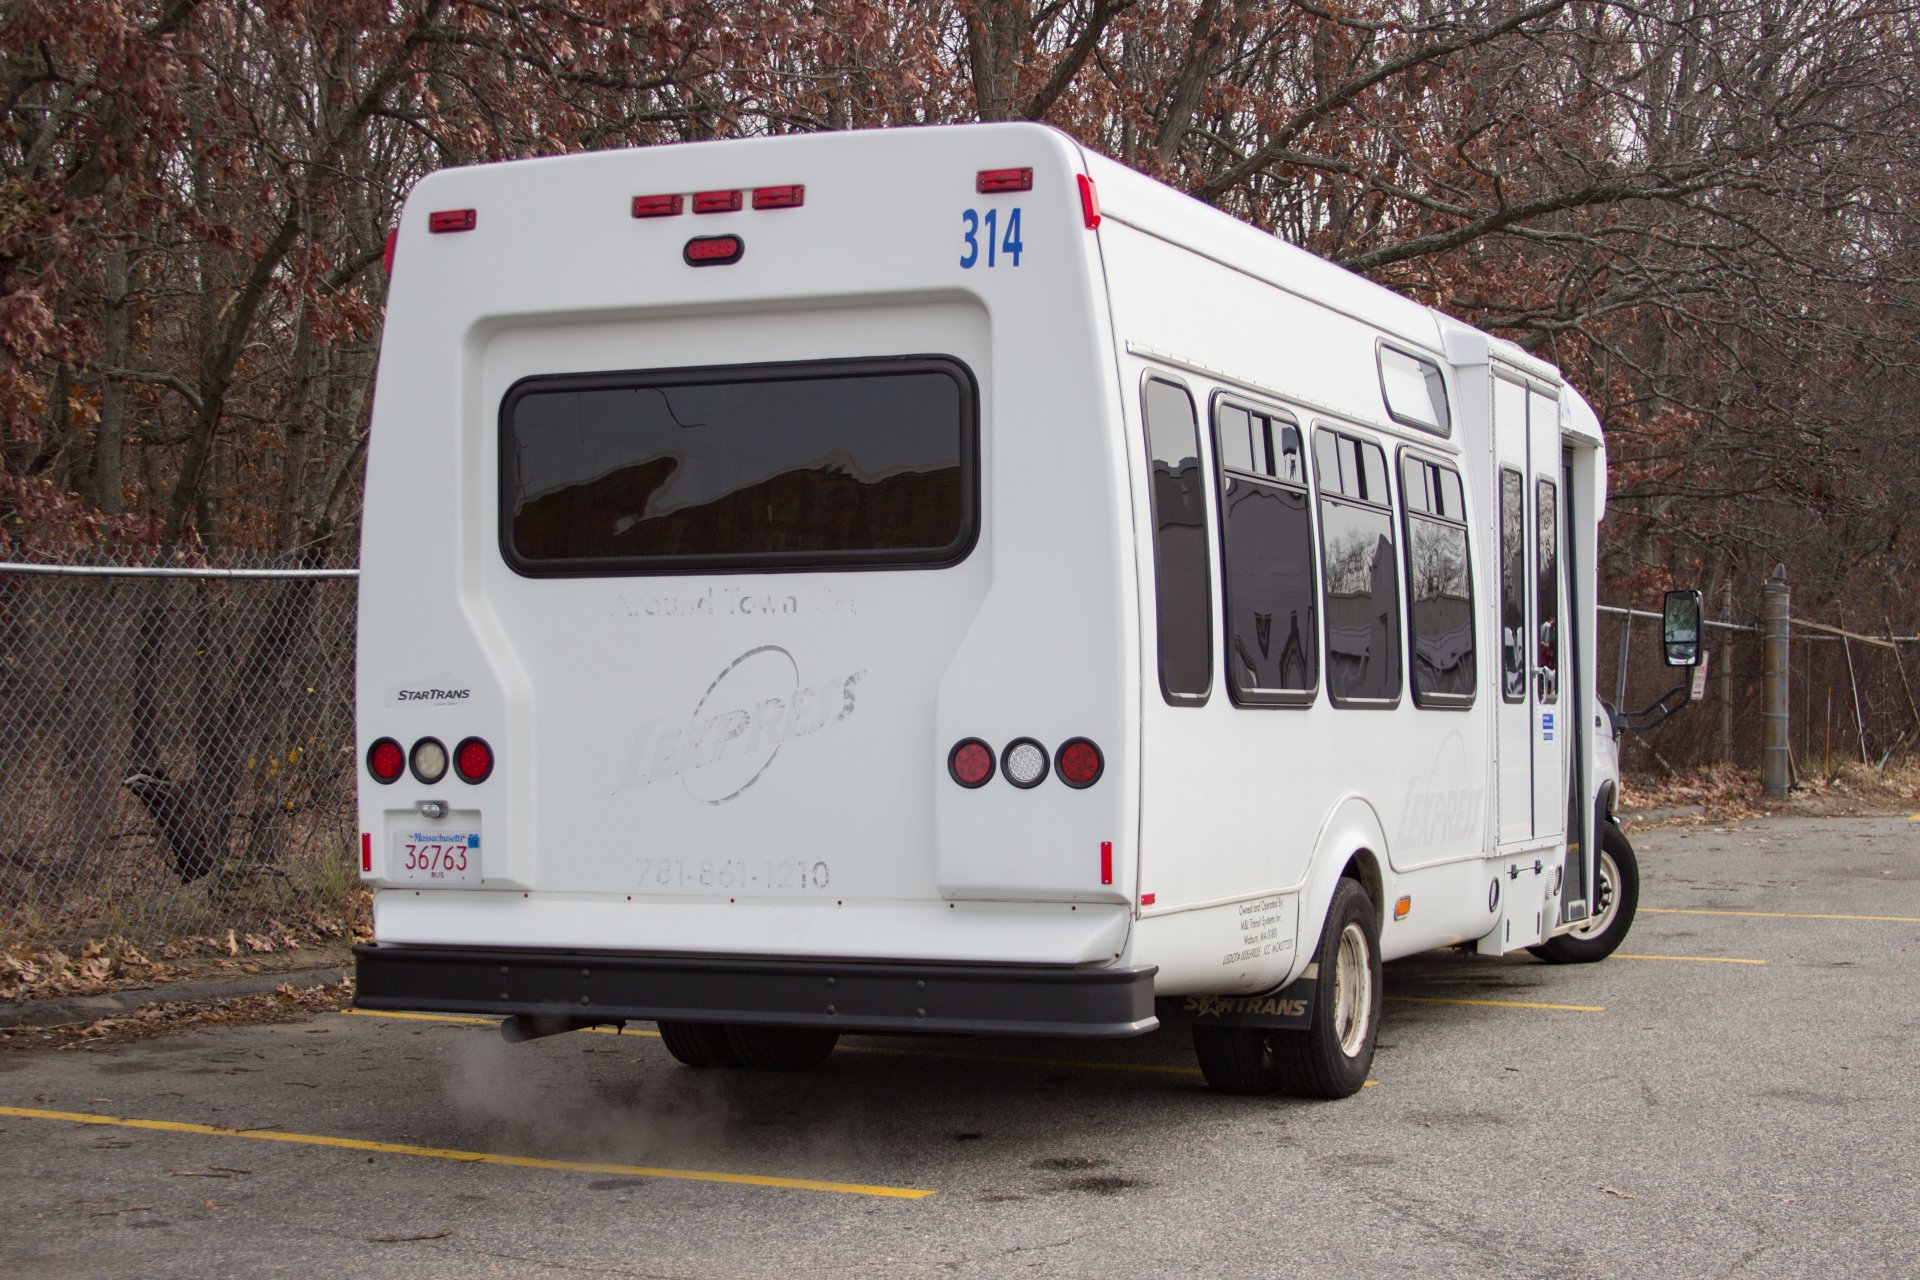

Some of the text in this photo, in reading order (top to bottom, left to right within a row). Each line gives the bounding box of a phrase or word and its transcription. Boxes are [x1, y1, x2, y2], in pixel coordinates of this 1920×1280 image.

[960, 208, 1023, 269] 314
[413, 832, 464, 843] Massachusetts
[470, 839, 478, 848] 19
[405, 844, 468, 871] 36763
[431, 871, 445, 879] BUS
[1238, 904, 1253, 916] Owned
